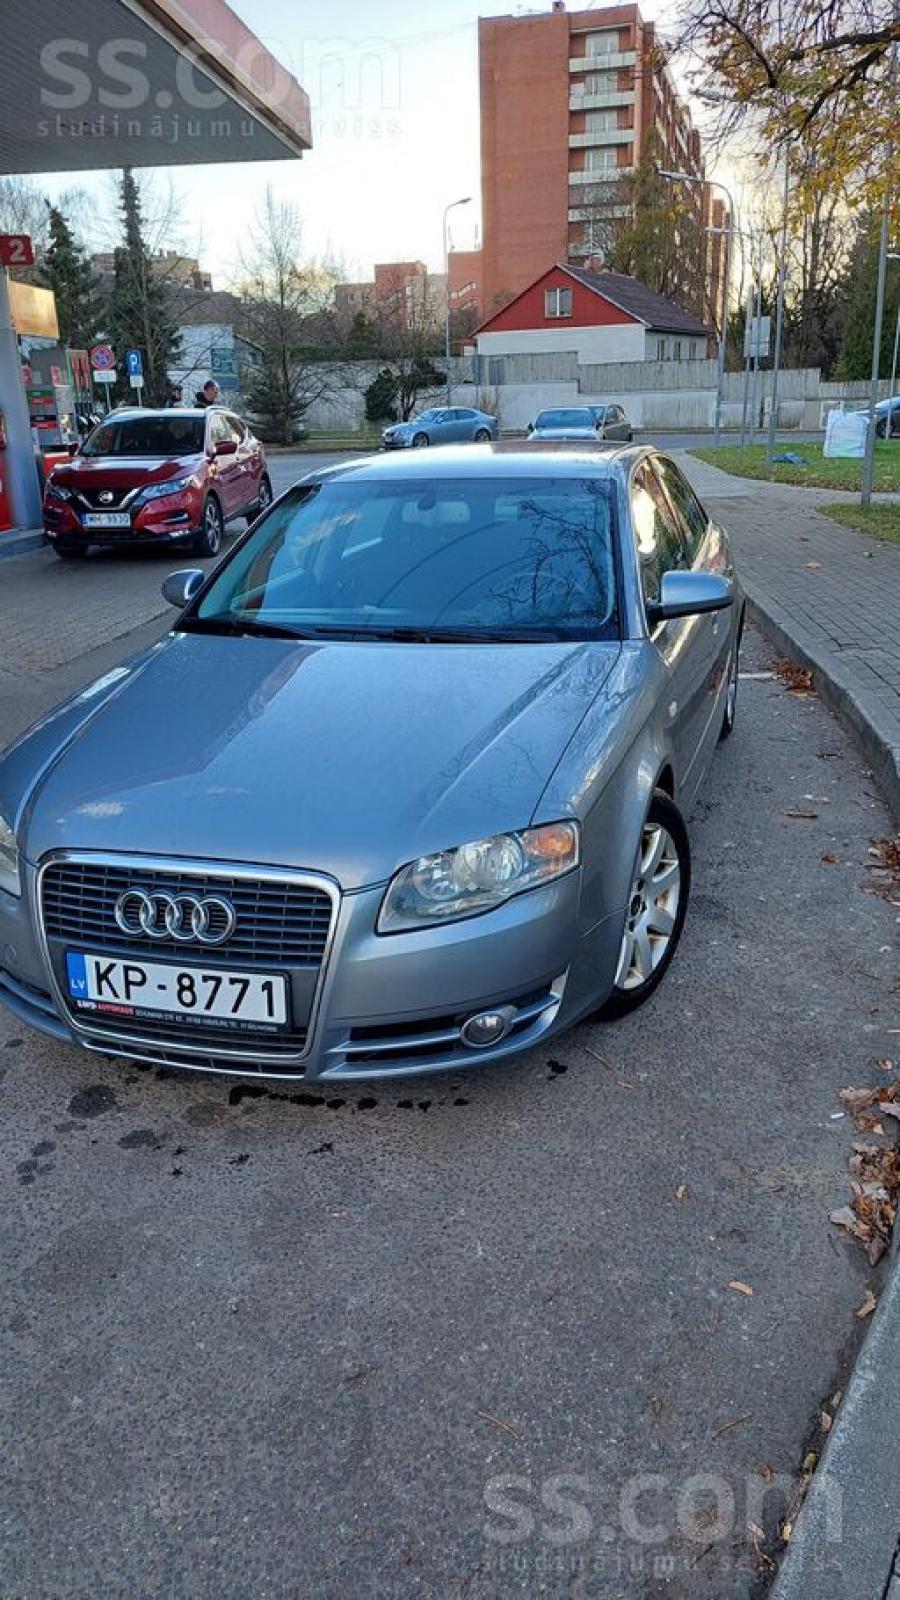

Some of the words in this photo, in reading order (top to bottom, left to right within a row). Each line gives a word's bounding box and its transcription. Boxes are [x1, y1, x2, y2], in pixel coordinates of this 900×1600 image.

[9, 238, 26, 262] 2
[71, 979, 85, 989] LV
[94, 961, 275, 1017] KP-8771
